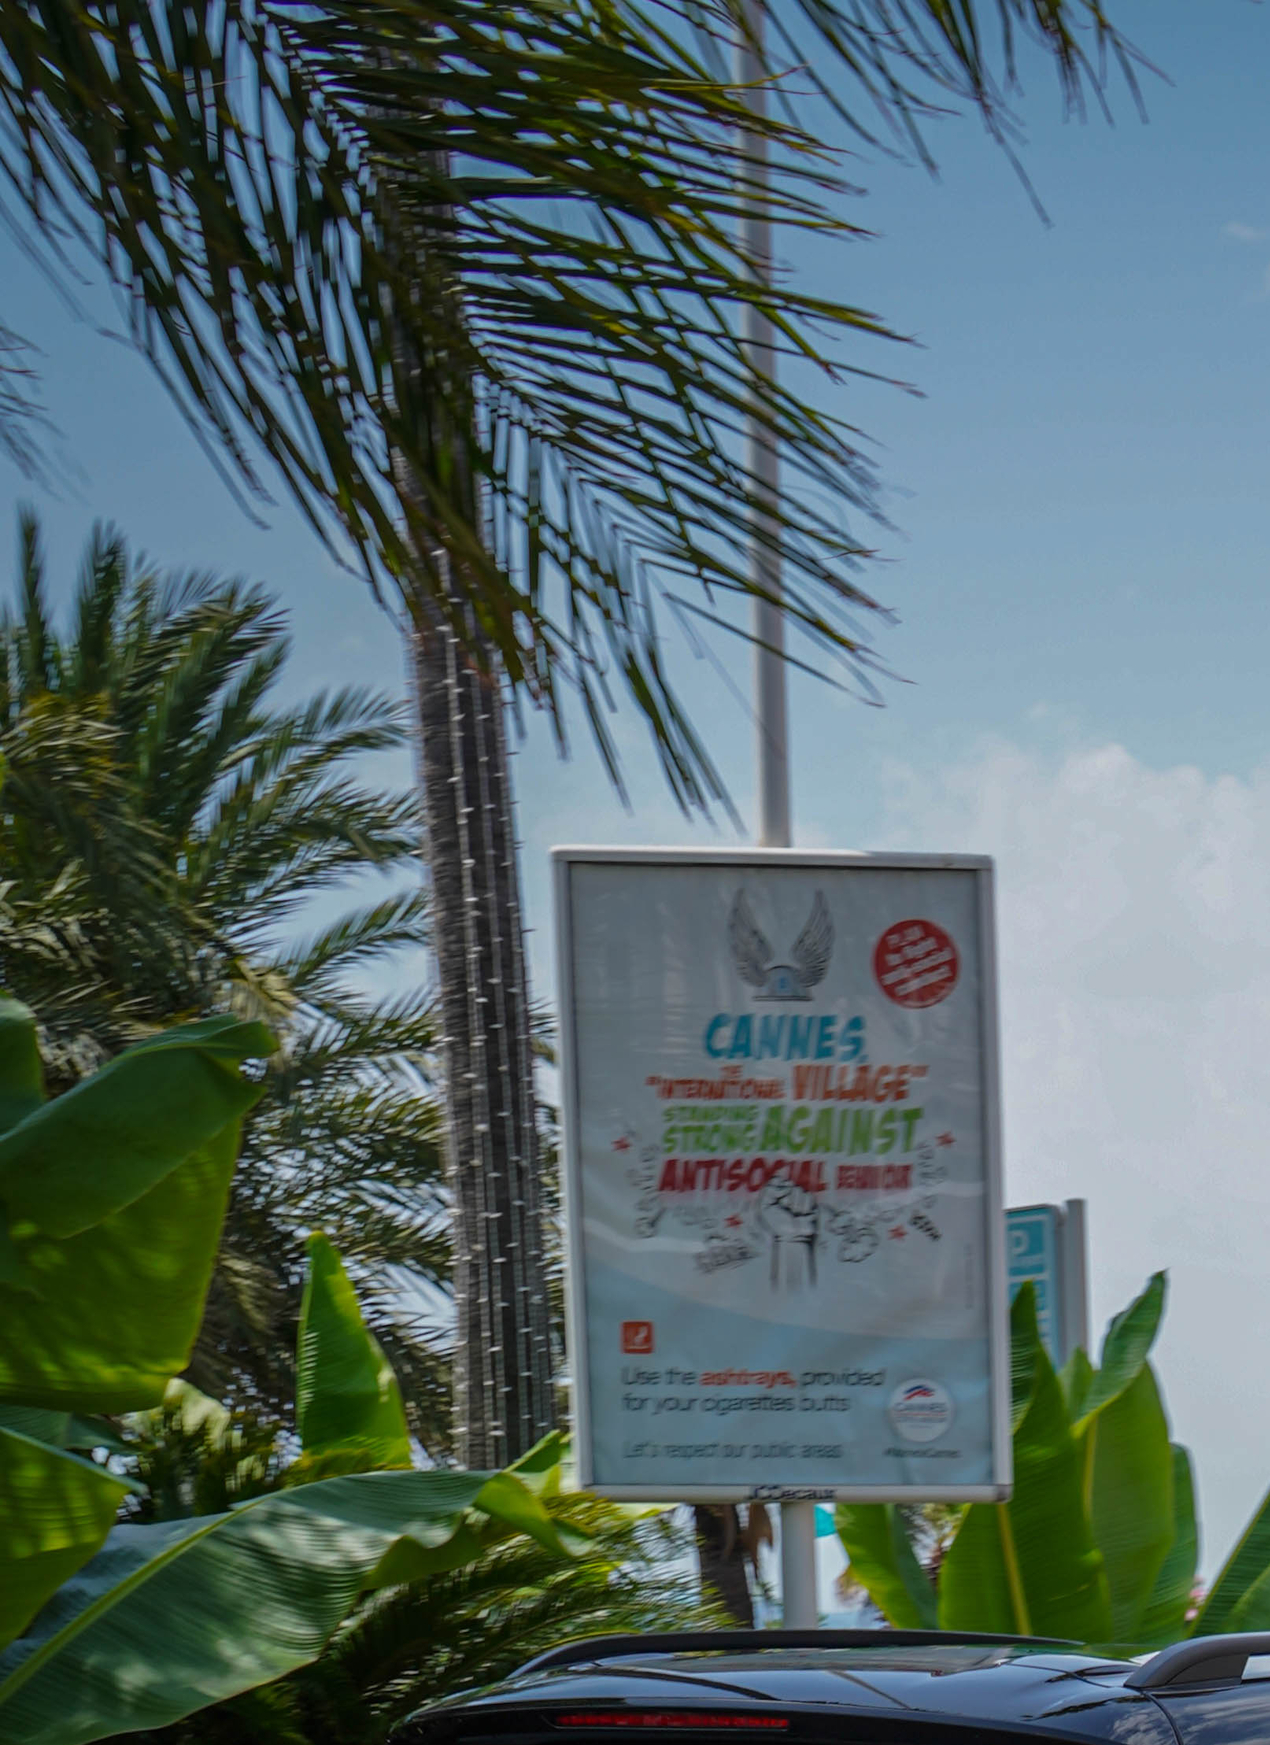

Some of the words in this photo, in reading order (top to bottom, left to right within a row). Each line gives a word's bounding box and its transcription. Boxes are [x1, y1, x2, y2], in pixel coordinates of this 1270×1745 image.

[662, 1122, 757, 1154] STRONG
[758, 1104, 925, 1155] AGAINST
[620, 1367, 661, 1386] Use
[664, 1366, 697, 1385] the
[699, 1367, 798, 1389] ashtrays,
[800, 1368, 886, 1390] provided
[622, 1392, 650, 1412] for
[651, 1397, 699, 1416] your
[702, 1393, 797, 1416] cigarettes
[800, 1394, 851, 1413] butts
[723, 1443, 748, 1459] our
[751, 1441, 797, 1461] public
[800, 1443, 844, 1460] areas
